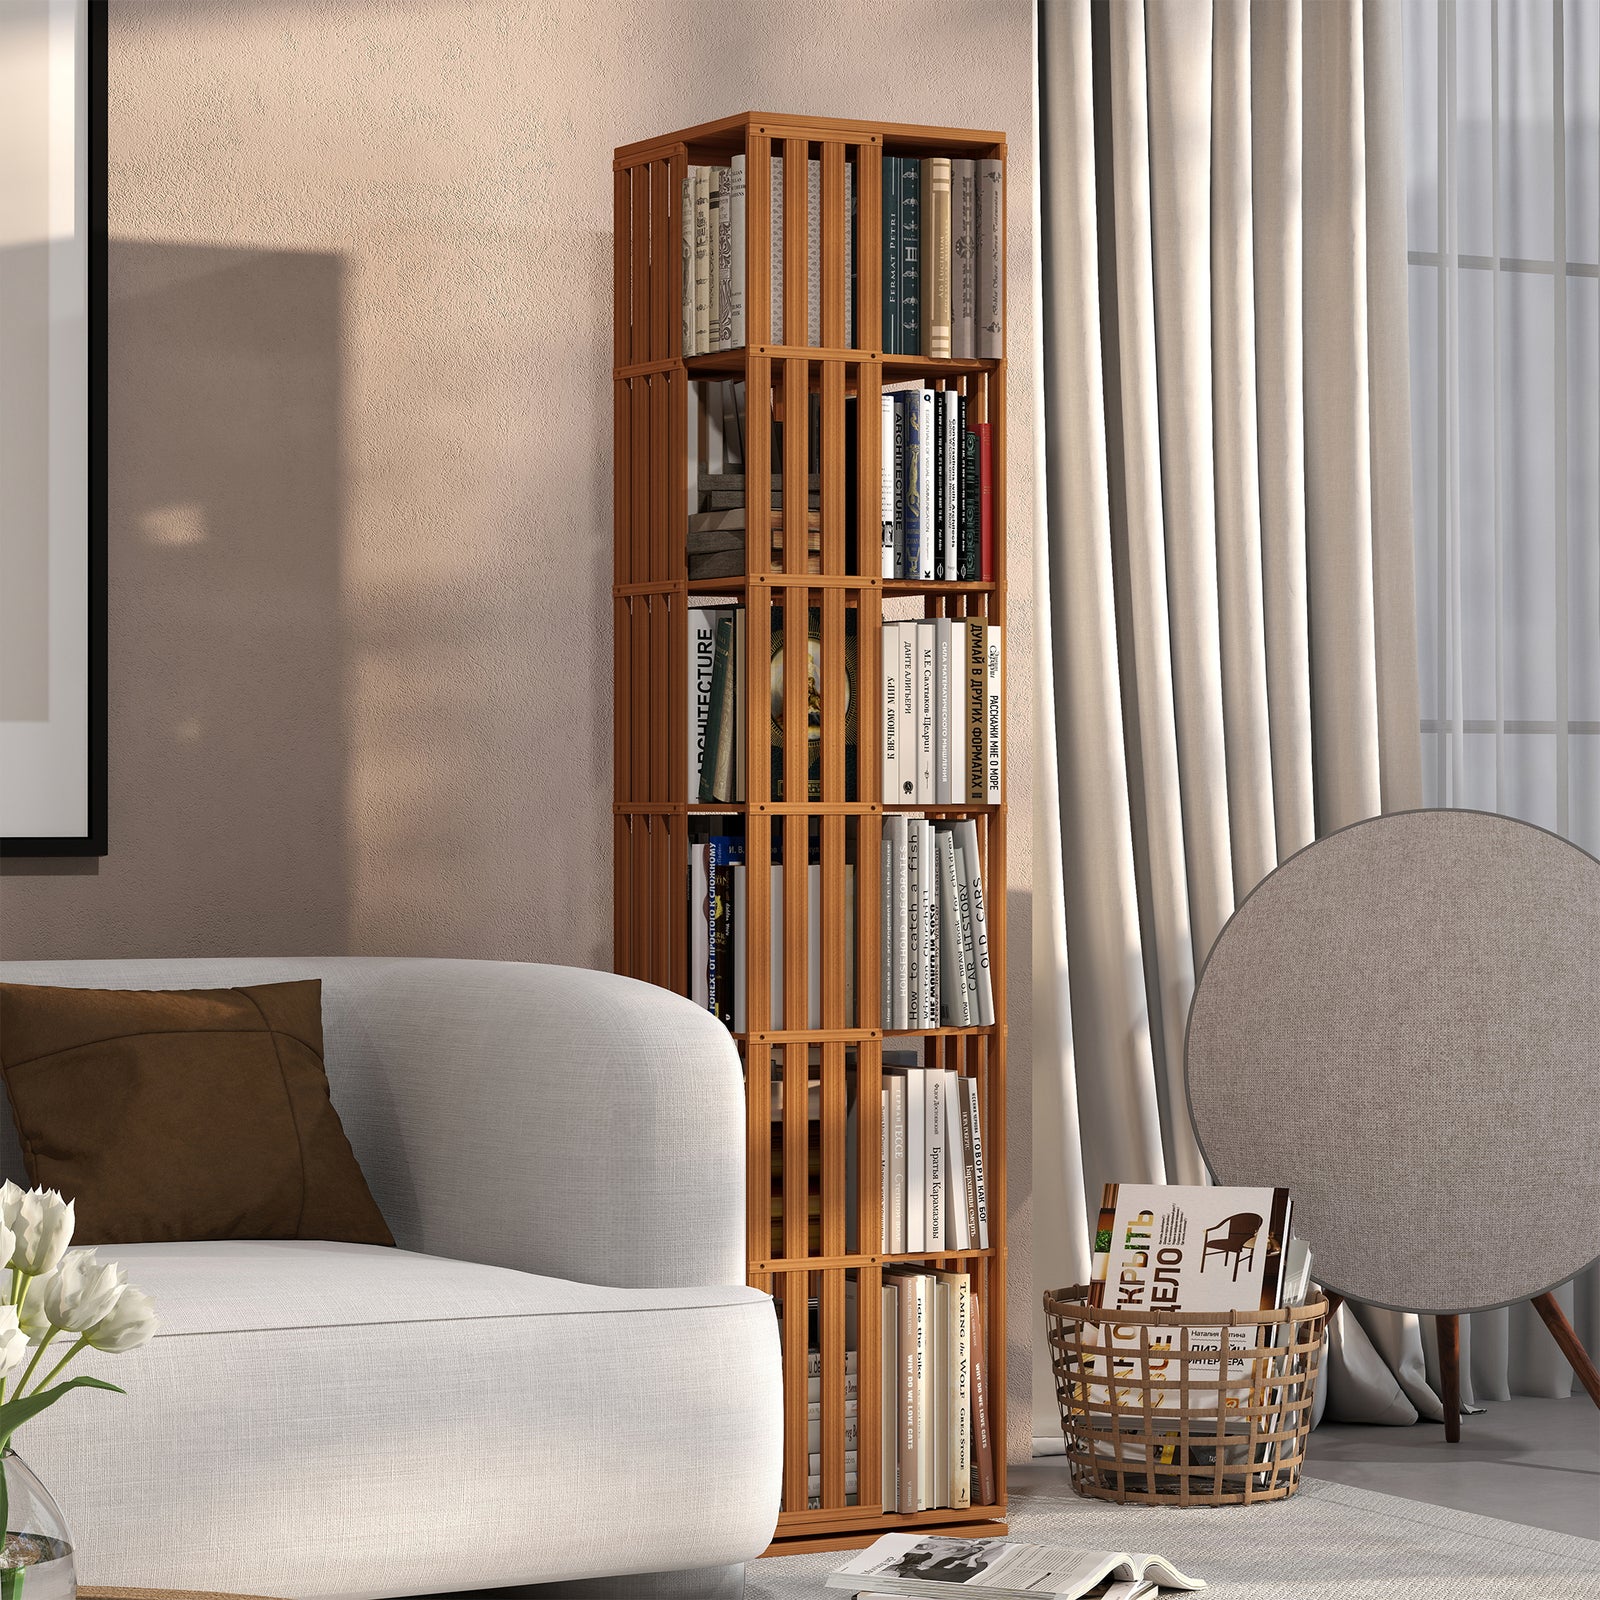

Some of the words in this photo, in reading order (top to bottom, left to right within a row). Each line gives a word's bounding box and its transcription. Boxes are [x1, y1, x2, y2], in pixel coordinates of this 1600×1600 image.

[895, 413, 903, 531] ARCHITECTURE
[904, 641, 912, 670] ДАНТЕ
[924, 650, 932, 668] М.Е.
[971, 624, 985, 665] ДУМАЙ
[887, 676, 895, 705] МИРУ
[904, 671, 912, 715] АЛИГЬЕРИ
[971, 680, 983, 723] ДРУГИХ
[887, 707, 895, 751] ВЕЧНОМУ
[922, 670, 932, 754] Салтыков-Щедрин
[990, 696, 999, 739] РАССКАЖИ
[971, 727, 983, 789] ФОРМАТАХ
[990, 741, 999, 759] МНЕ
[990, 769, 999, 792] МОРЕ
[709, 842, 717, 898] СЛОЖНОМУ
[908, 835, 918, 873] fish
[947, 836, 957, 888] children
[911, 884, 918, 893] a
[972, 877, 985, 923] CARS
[908, 903, 918, 951] catch
[959, 884, 974, 953] HISTORY
[709, 959, 716, 971] ОТ
[978, 935, 989, 969] OLD
[909, 962, 918, 981] to
[966, 961, 977, 992] CAR
[909, 991, 918, 1020] How
[894, 1125, 903, 1159] ГЕССЕ
[930, 1147, 941, 1180] Братья
[974, 1138, 983, 1182] ГОВОРИ
[894, 1174, 904, 1218] Степной
[965, 1165, 975, 1208] Бархатная
[977, 1185, 985, 1203] КАК
[930, 1182, 941, 1239] Карамазовы
[968, 1209, 977, 1238] смерть
[979, 1207, 987, 1223] БОГ
[959, 1282, 967, 1338] TAMING
[907, 1376, 913, 1388] DO
[907, 1390, 913, 1404] WE
[977, 1383, 983, 1393] DO
[978, 1395, 984, 1408] WE
